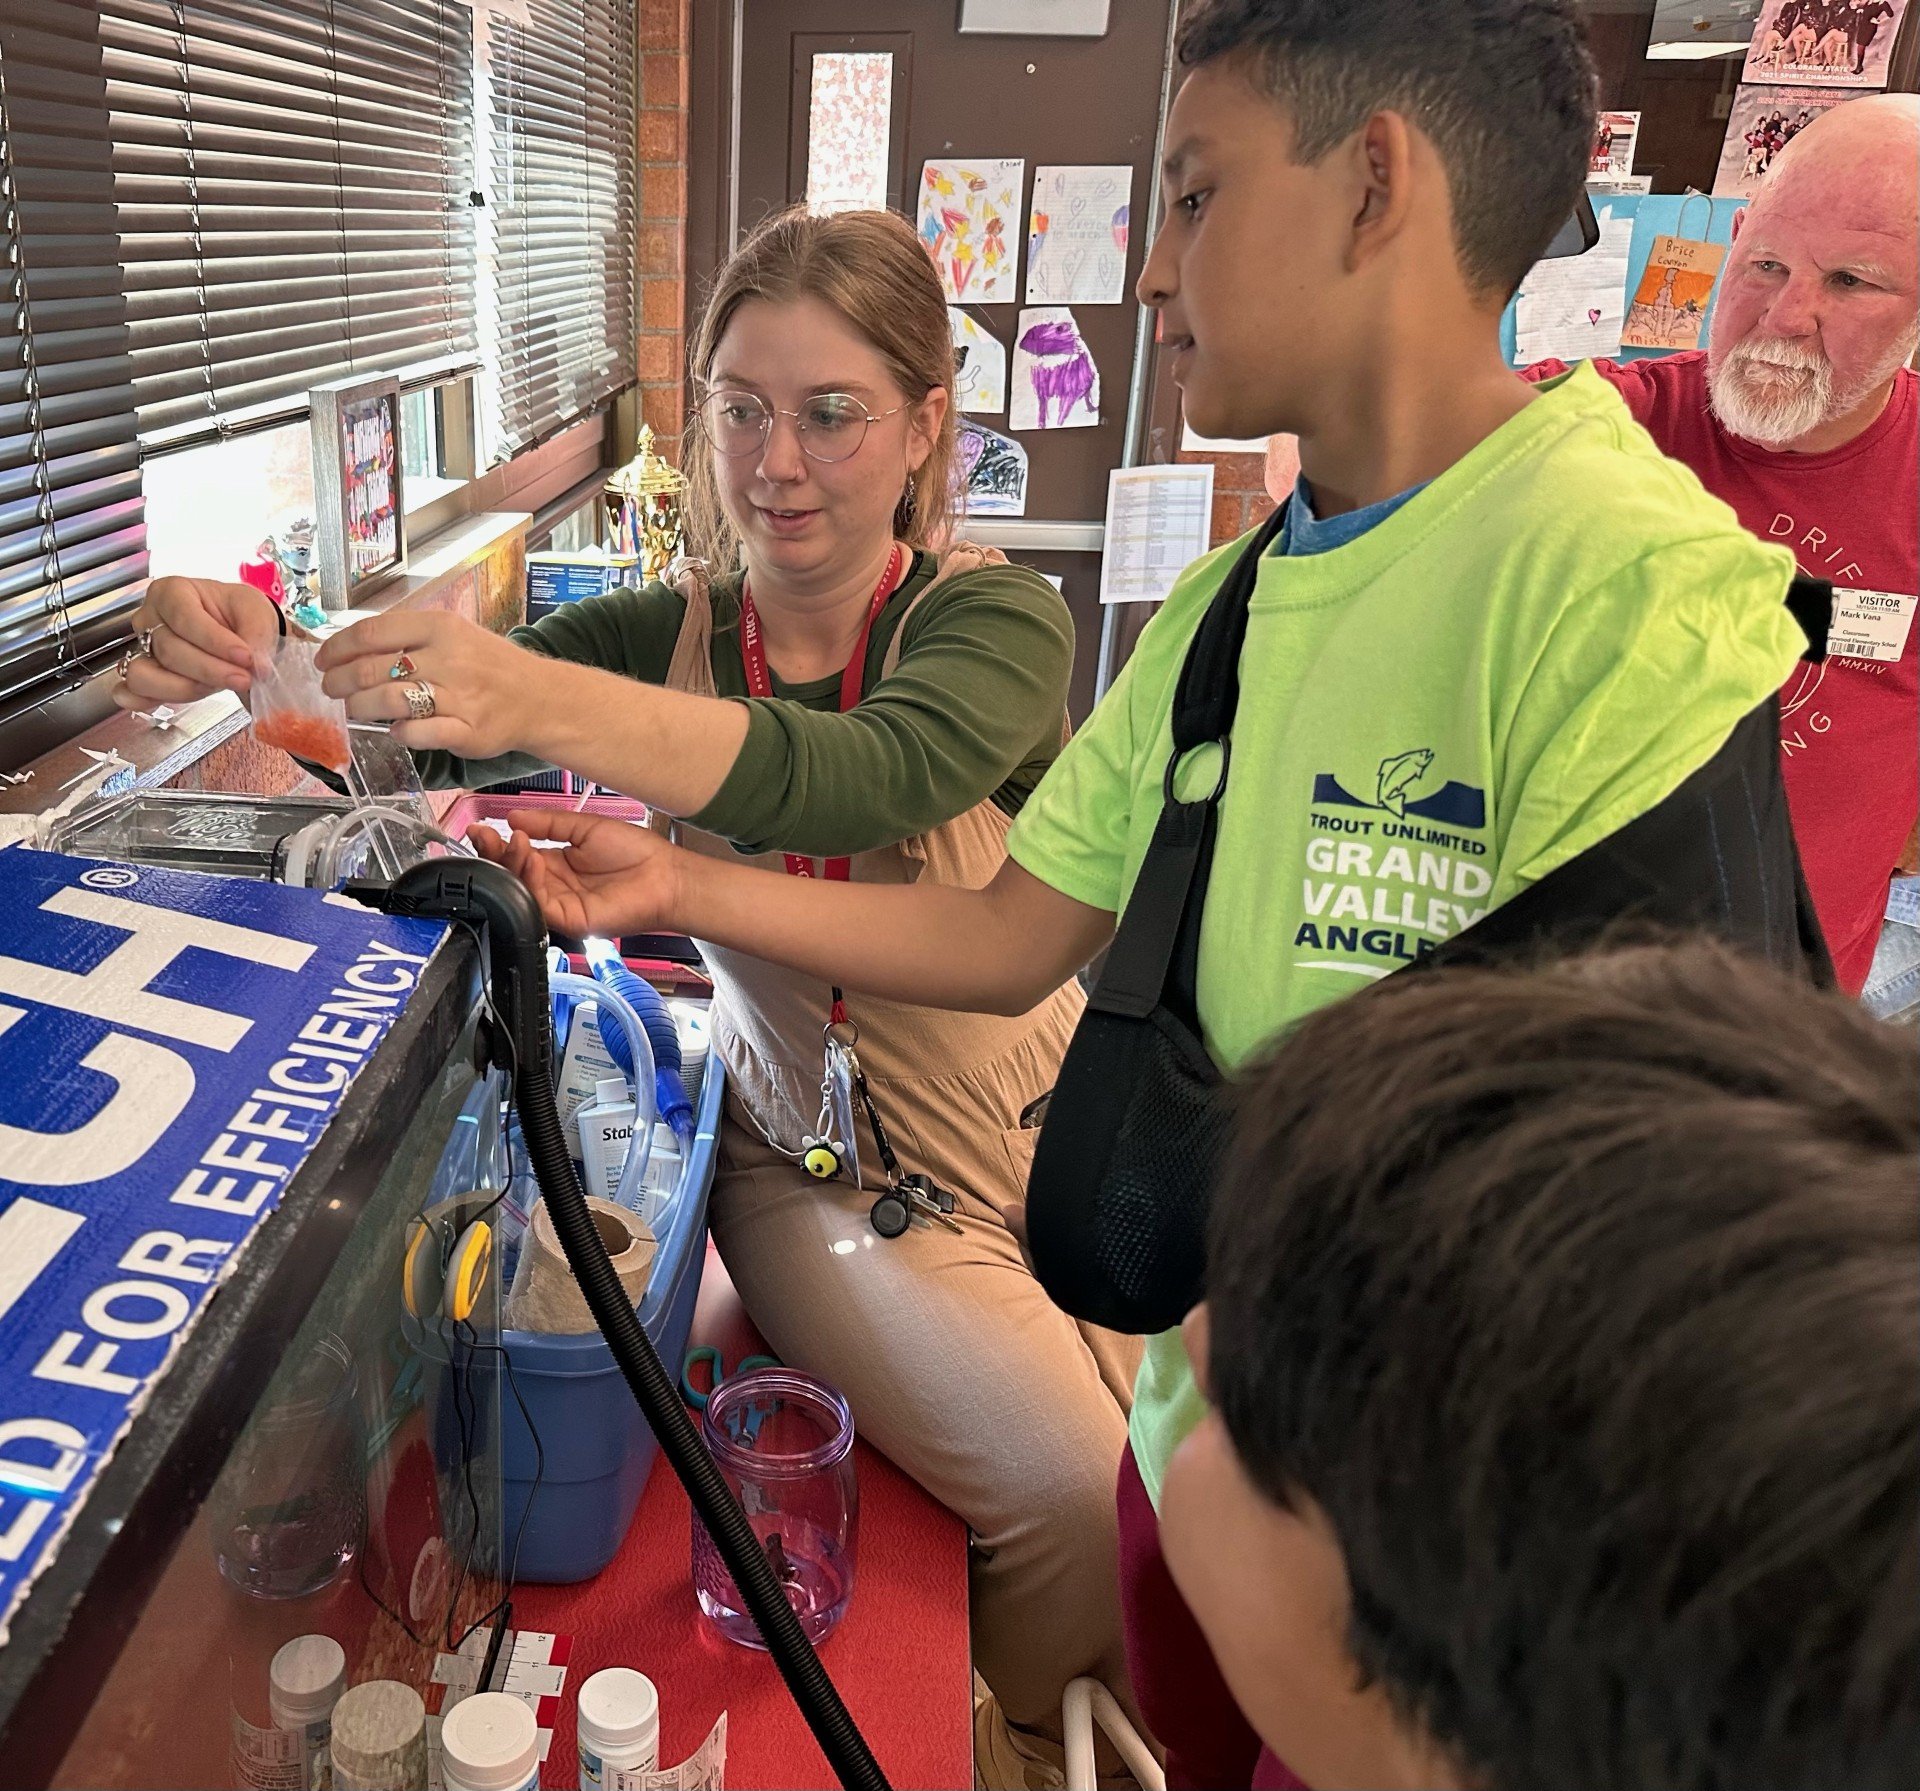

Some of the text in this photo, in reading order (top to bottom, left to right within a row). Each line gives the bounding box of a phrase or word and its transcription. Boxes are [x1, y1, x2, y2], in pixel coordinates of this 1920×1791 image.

[1782, 63, 1849, 73] COLORADO STATE
[1805, 74, 1868, 82] CHAMPIONSHIPS
[1666, 239, 1695, 258] Brice
[1768, 513, 1863, 581] DRIF
[1859, 595, 1900, 608] VISITOR
[1841, 610, 1881, 621] Mark Vana
[745, 611, 758, 650] TRIO
[1852, 638, 1880, 647] Elementary
[1881, 640, 1898, 648] School
[1838, 658, 1887, 675] MMXIV
[1310, 812, 1487, 856] TROUT UNLIMITED
[1305, 837, 1493, 898] GRAND
[1302, 879, 1489, 938] VALLEY
[1294, 922, 1437, 962] ANGLE
[602, 1124, 634, 1141] Stab
[31, 1229, 233, 1395] FOR
[169, 940, 428, 1217] EFFICIENCY
[523, 1691, 532, 1699] 10
